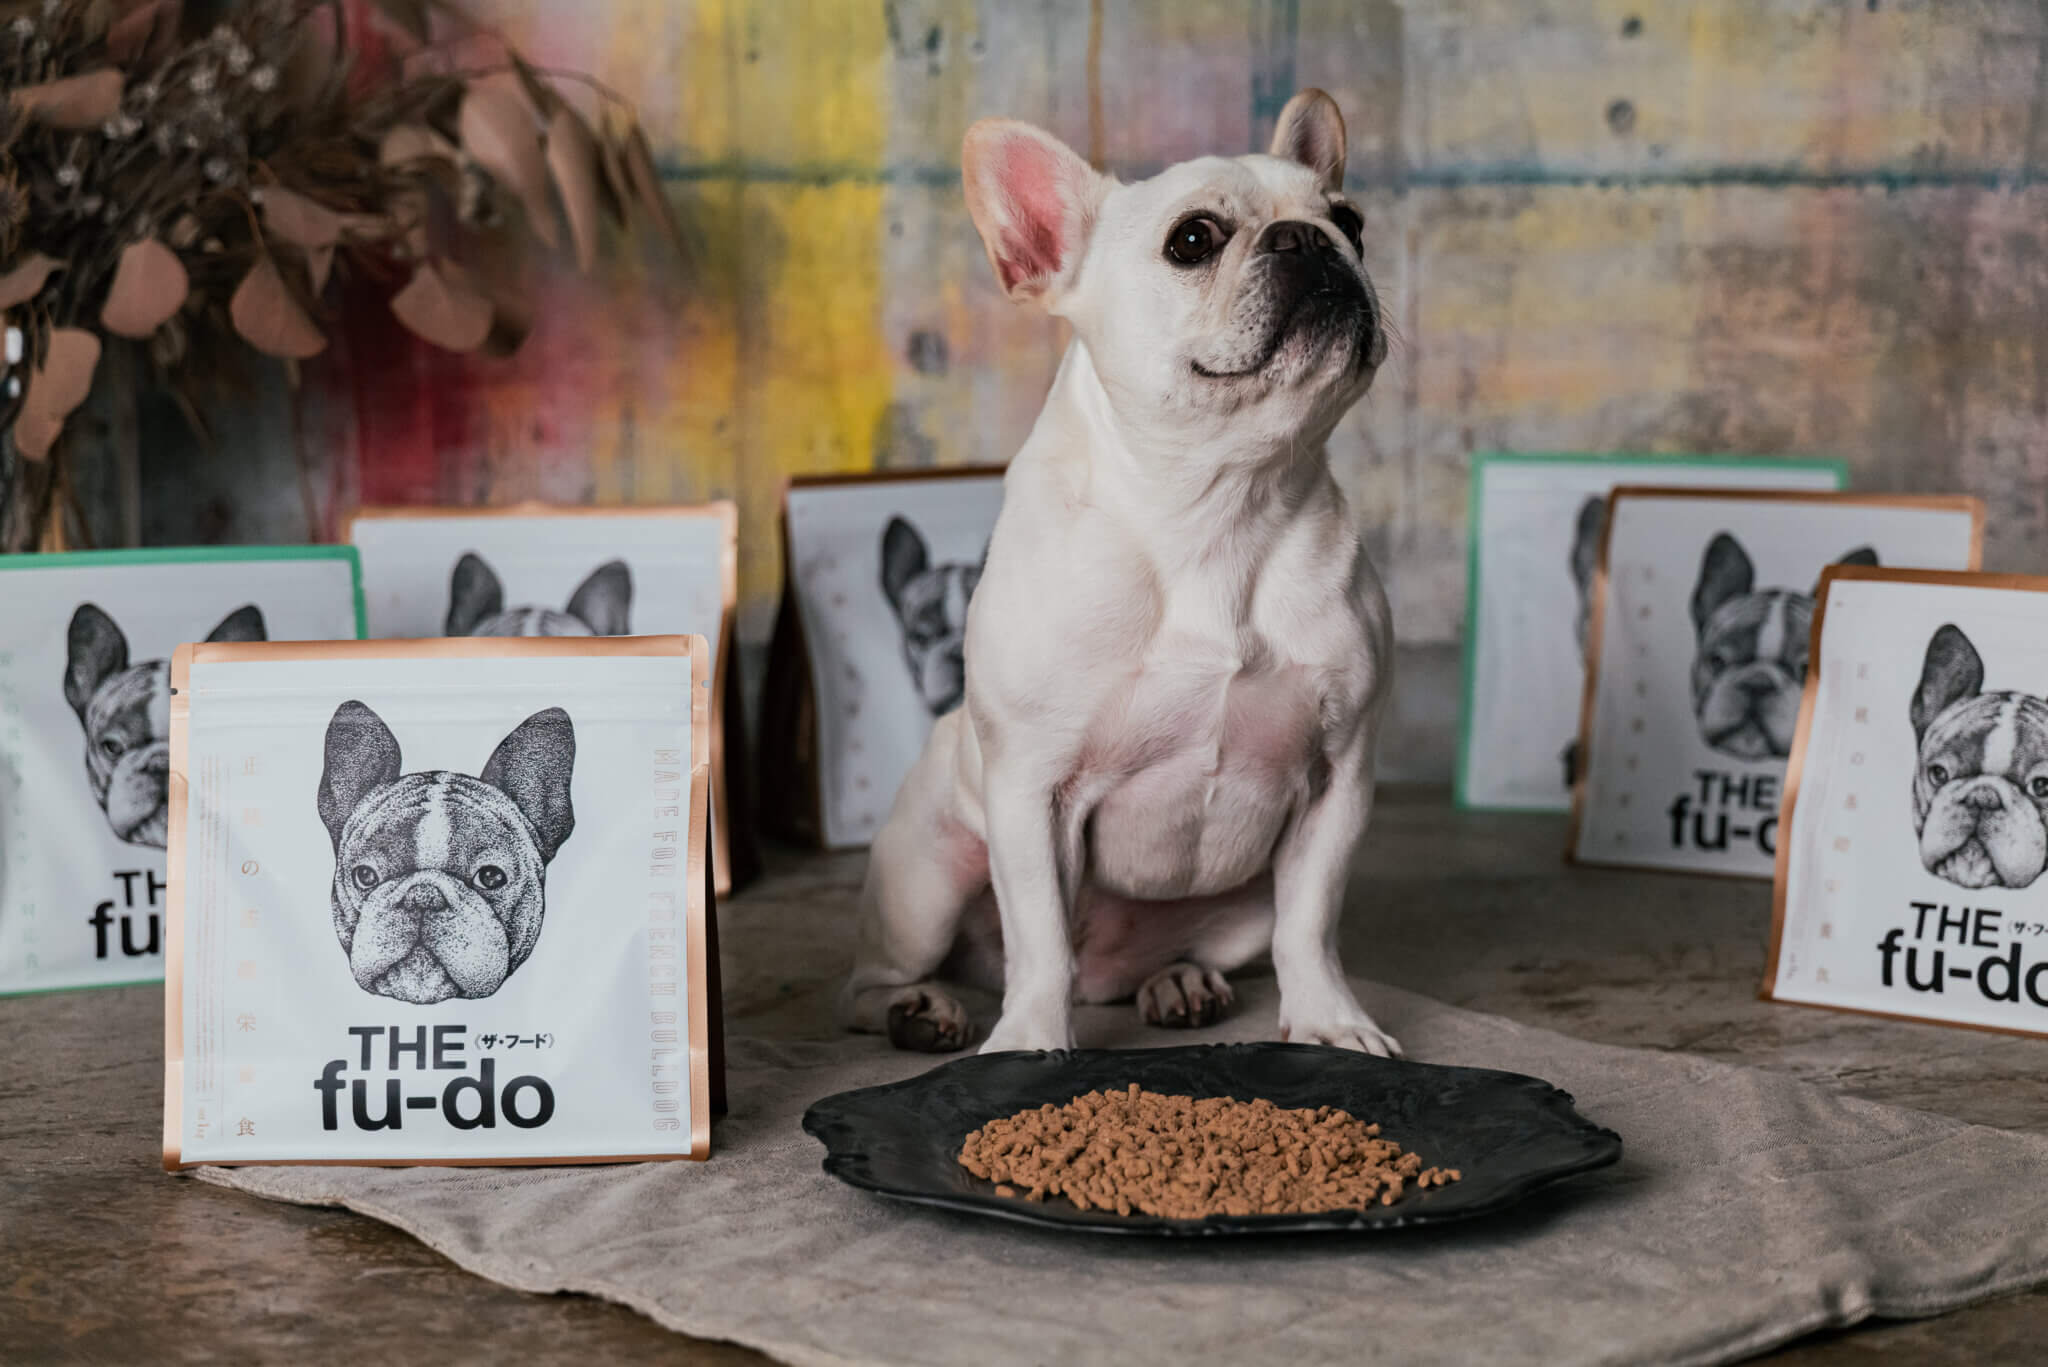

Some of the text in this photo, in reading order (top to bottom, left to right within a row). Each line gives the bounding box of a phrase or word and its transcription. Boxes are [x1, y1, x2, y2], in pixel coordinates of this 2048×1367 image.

[1695, 768, 1778, 811] THE
[1910, 901, 2002, 949] THE
[348, 1024, 468, 1071] THE
[650, 1011, 681, 1131] BULLDOG
[313, 1057, 556, 1131] fu-do
